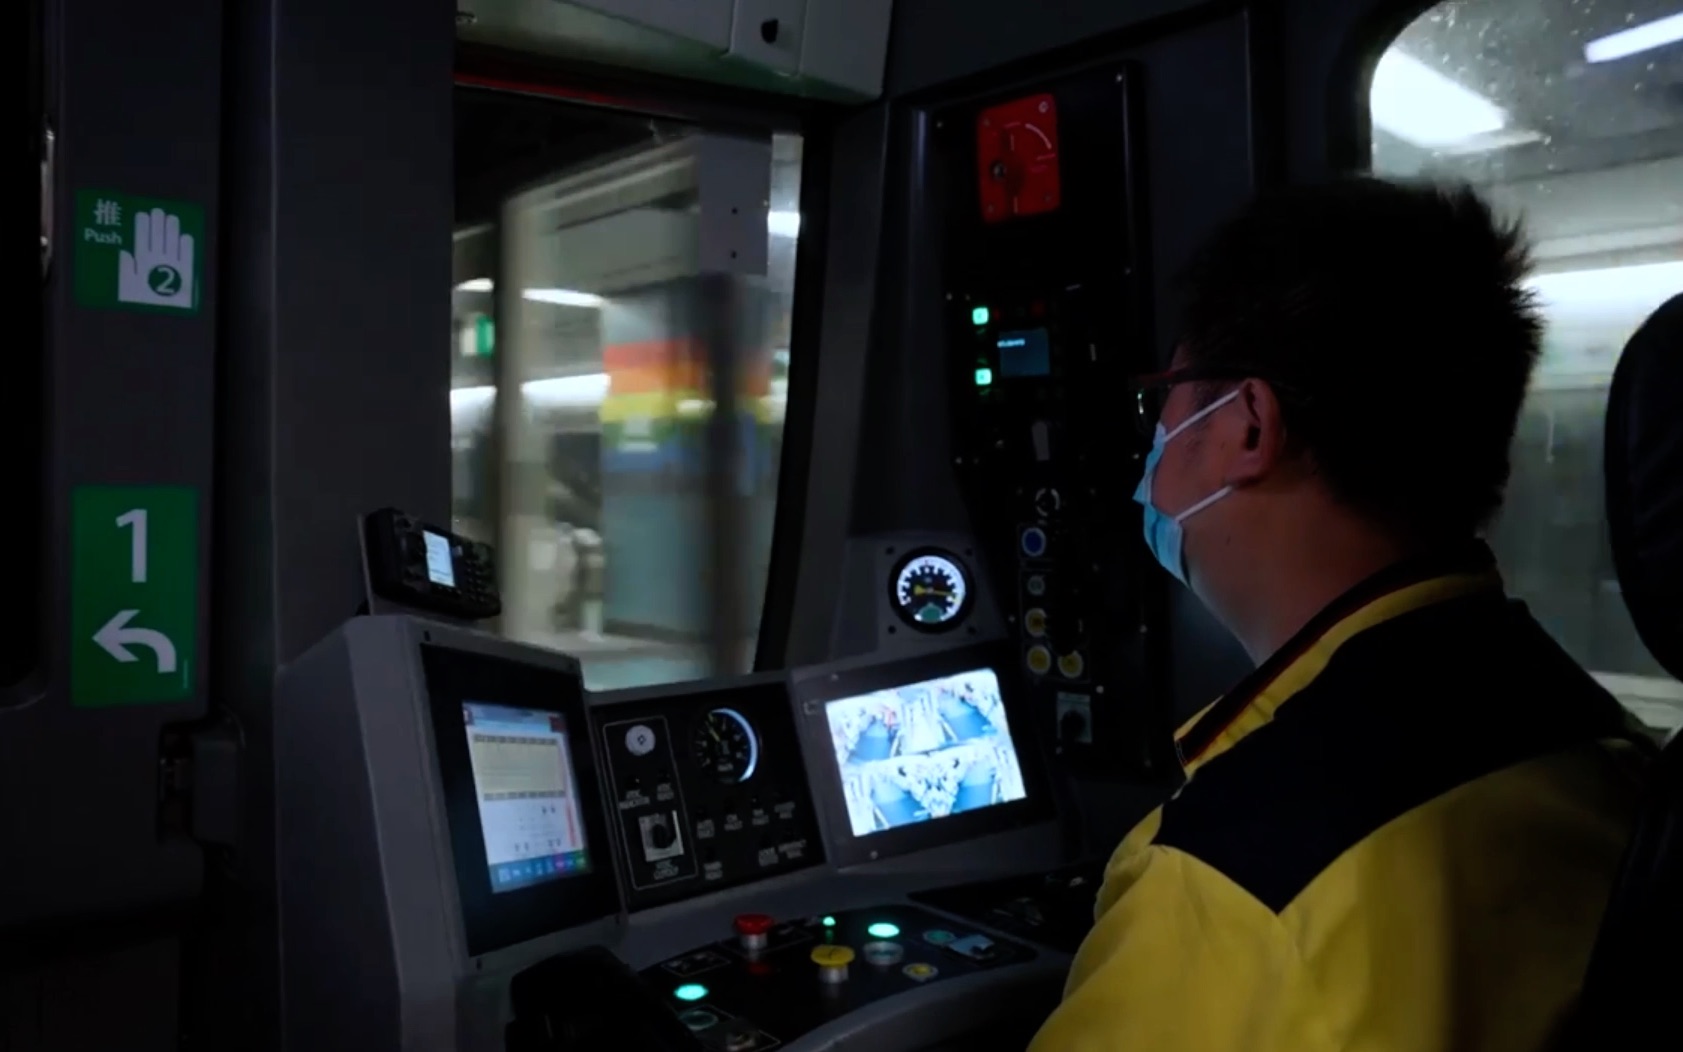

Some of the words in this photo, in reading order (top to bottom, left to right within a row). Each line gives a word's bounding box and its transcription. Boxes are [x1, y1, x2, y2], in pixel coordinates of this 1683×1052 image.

[93, 198, 122, 226] 推
[84, 227, 122, 246] Push
[155, 267, 176, 294] 2
[115, 508, 148, 584] 1
